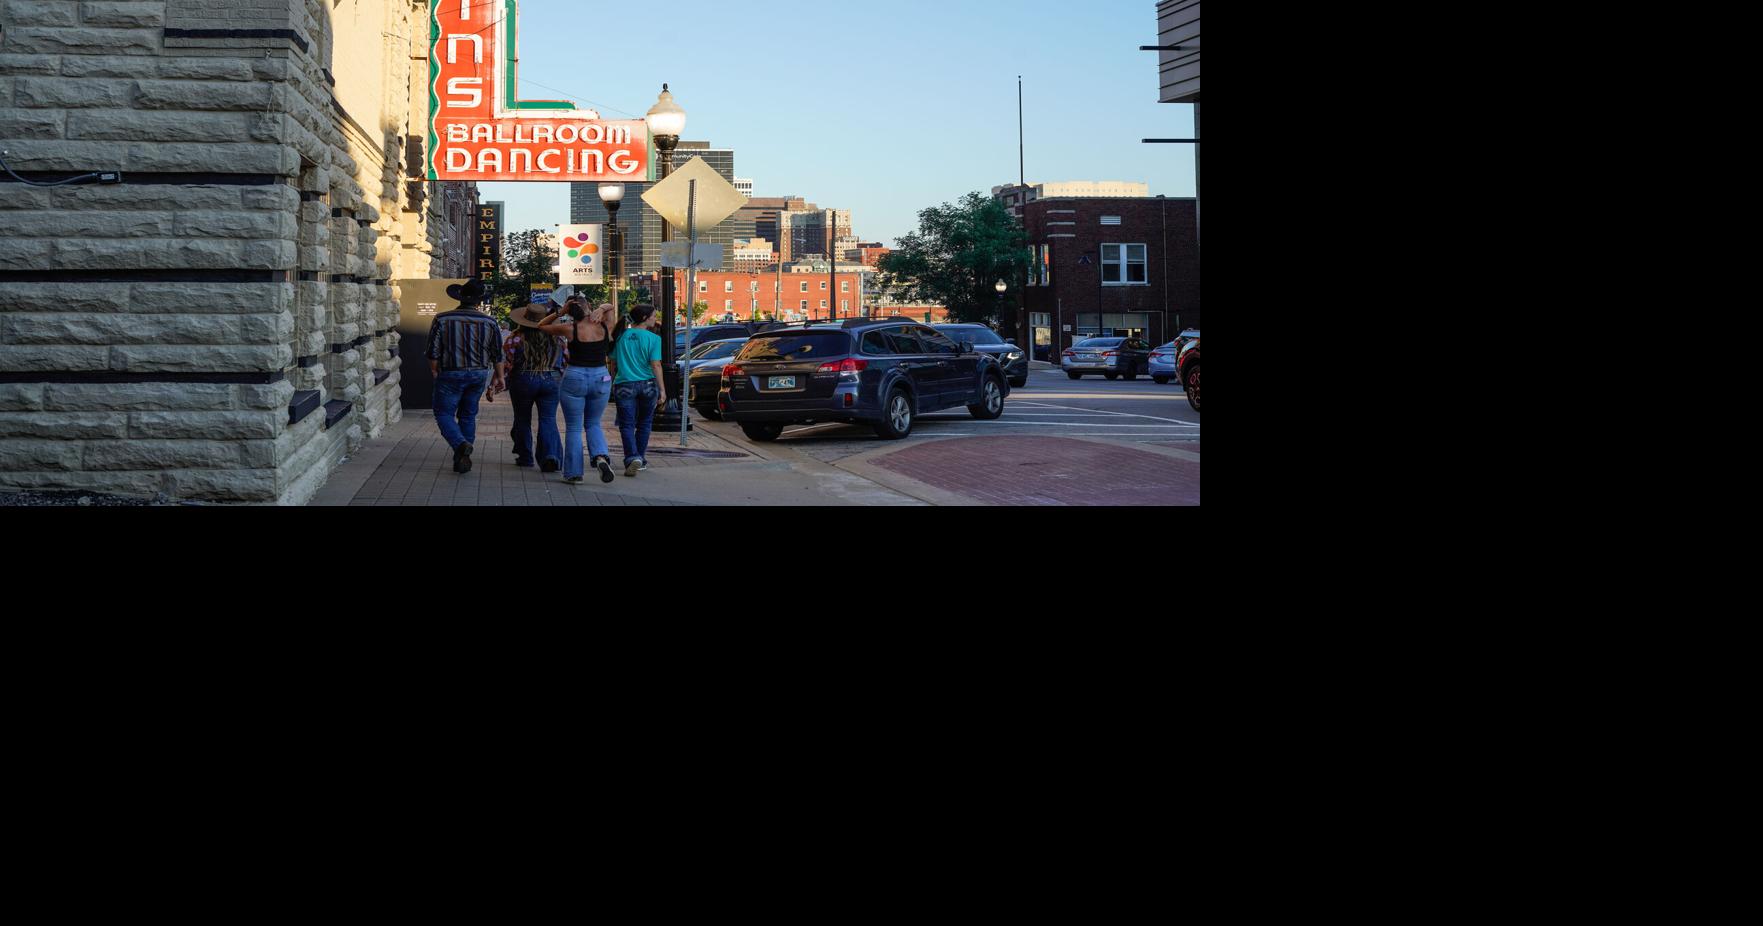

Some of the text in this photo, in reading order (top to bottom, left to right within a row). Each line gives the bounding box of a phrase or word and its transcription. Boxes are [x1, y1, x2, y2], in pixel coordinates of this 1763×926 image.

[446, 123, 631, 144] BALLROOM
[446, 147, 639, 174] DANCING
[479, 208, 496, 281] EMPIRE
